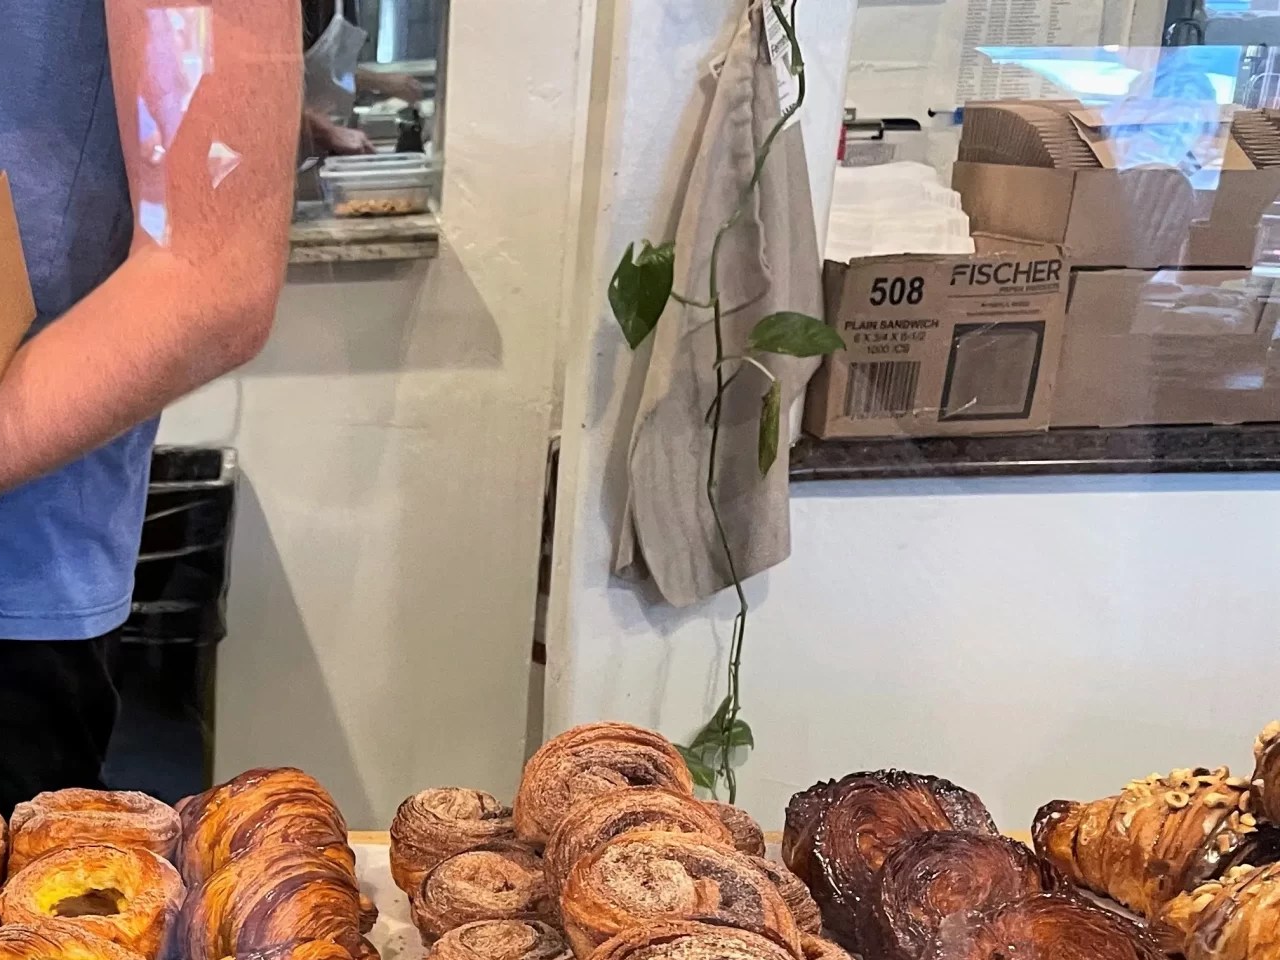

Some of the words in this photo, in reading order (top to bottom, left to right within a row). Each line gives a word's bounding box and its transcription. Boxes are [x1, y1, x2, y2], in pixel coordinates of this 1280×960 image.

[870, 276, 924, 307] 508
[949, 259, 1063, 286] FISCHER
[880, 318, 939, 330] SANDWICH
